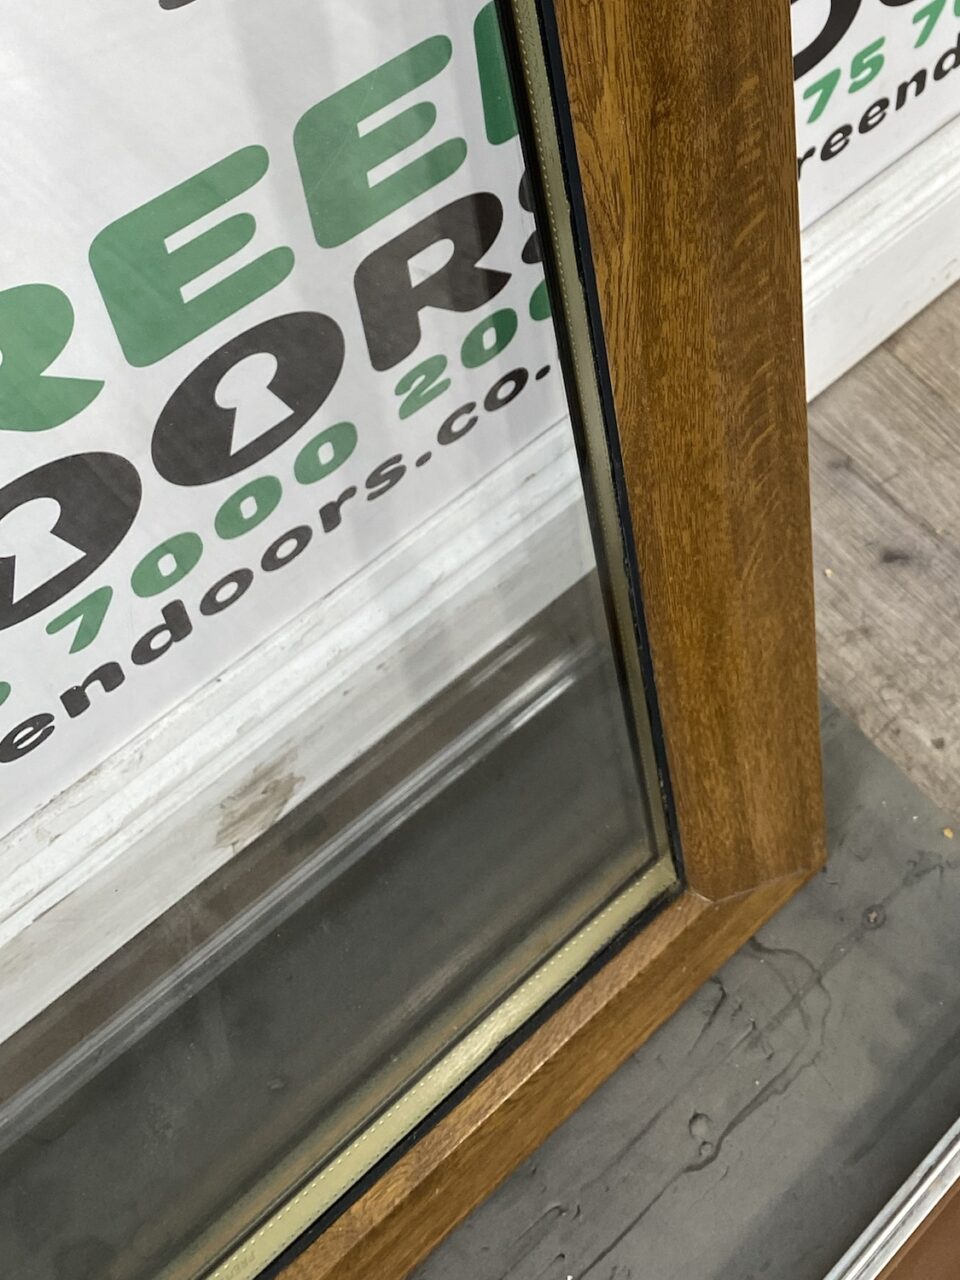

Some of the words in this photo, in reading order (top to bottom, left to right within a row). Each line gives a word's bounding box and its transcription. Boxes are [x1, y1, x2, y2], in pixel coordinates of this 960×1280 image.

[803, 36, 886, 125] 75
[0, 169, 545, 632] OOR
[46, 421, 358, 655] 7000
